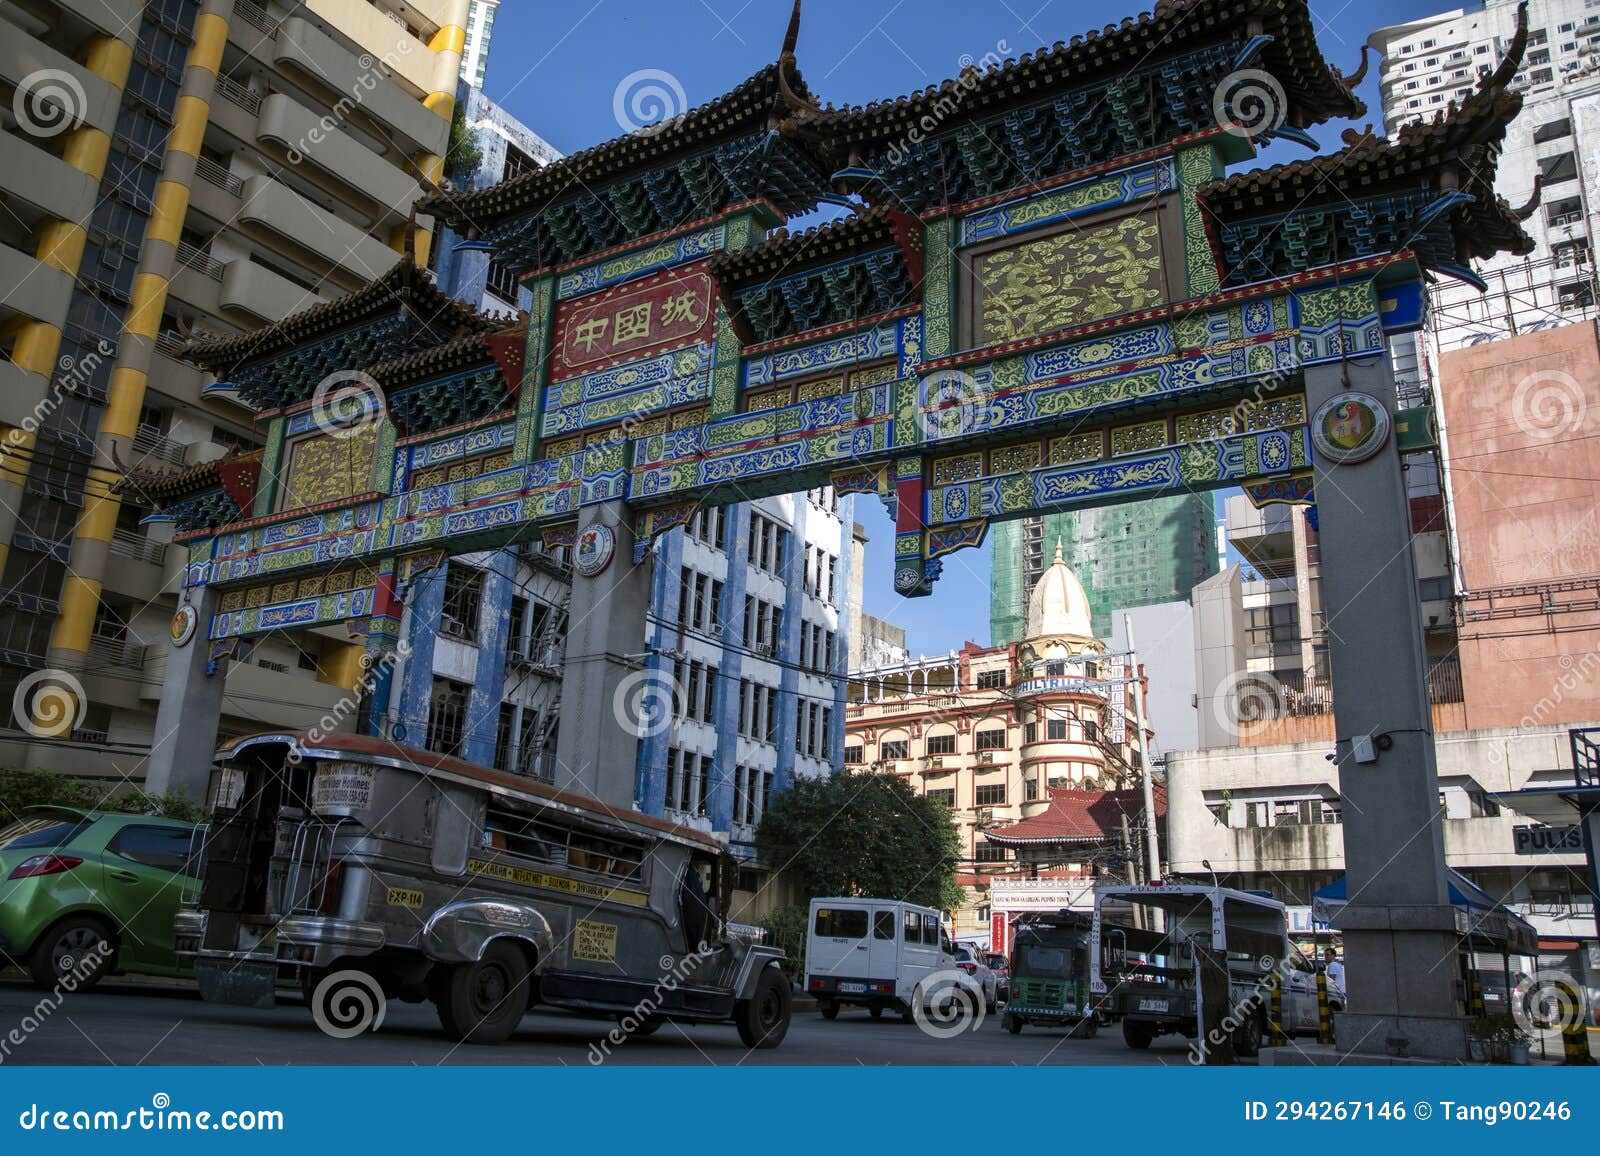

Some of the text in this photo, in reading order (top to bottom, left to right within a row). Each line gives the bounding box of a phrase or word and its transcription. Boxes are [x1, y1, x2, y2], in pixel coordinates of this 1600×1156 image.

[573, 290, 698, 353] 中國城
[1517, 830, 1581, 849] PULIS
